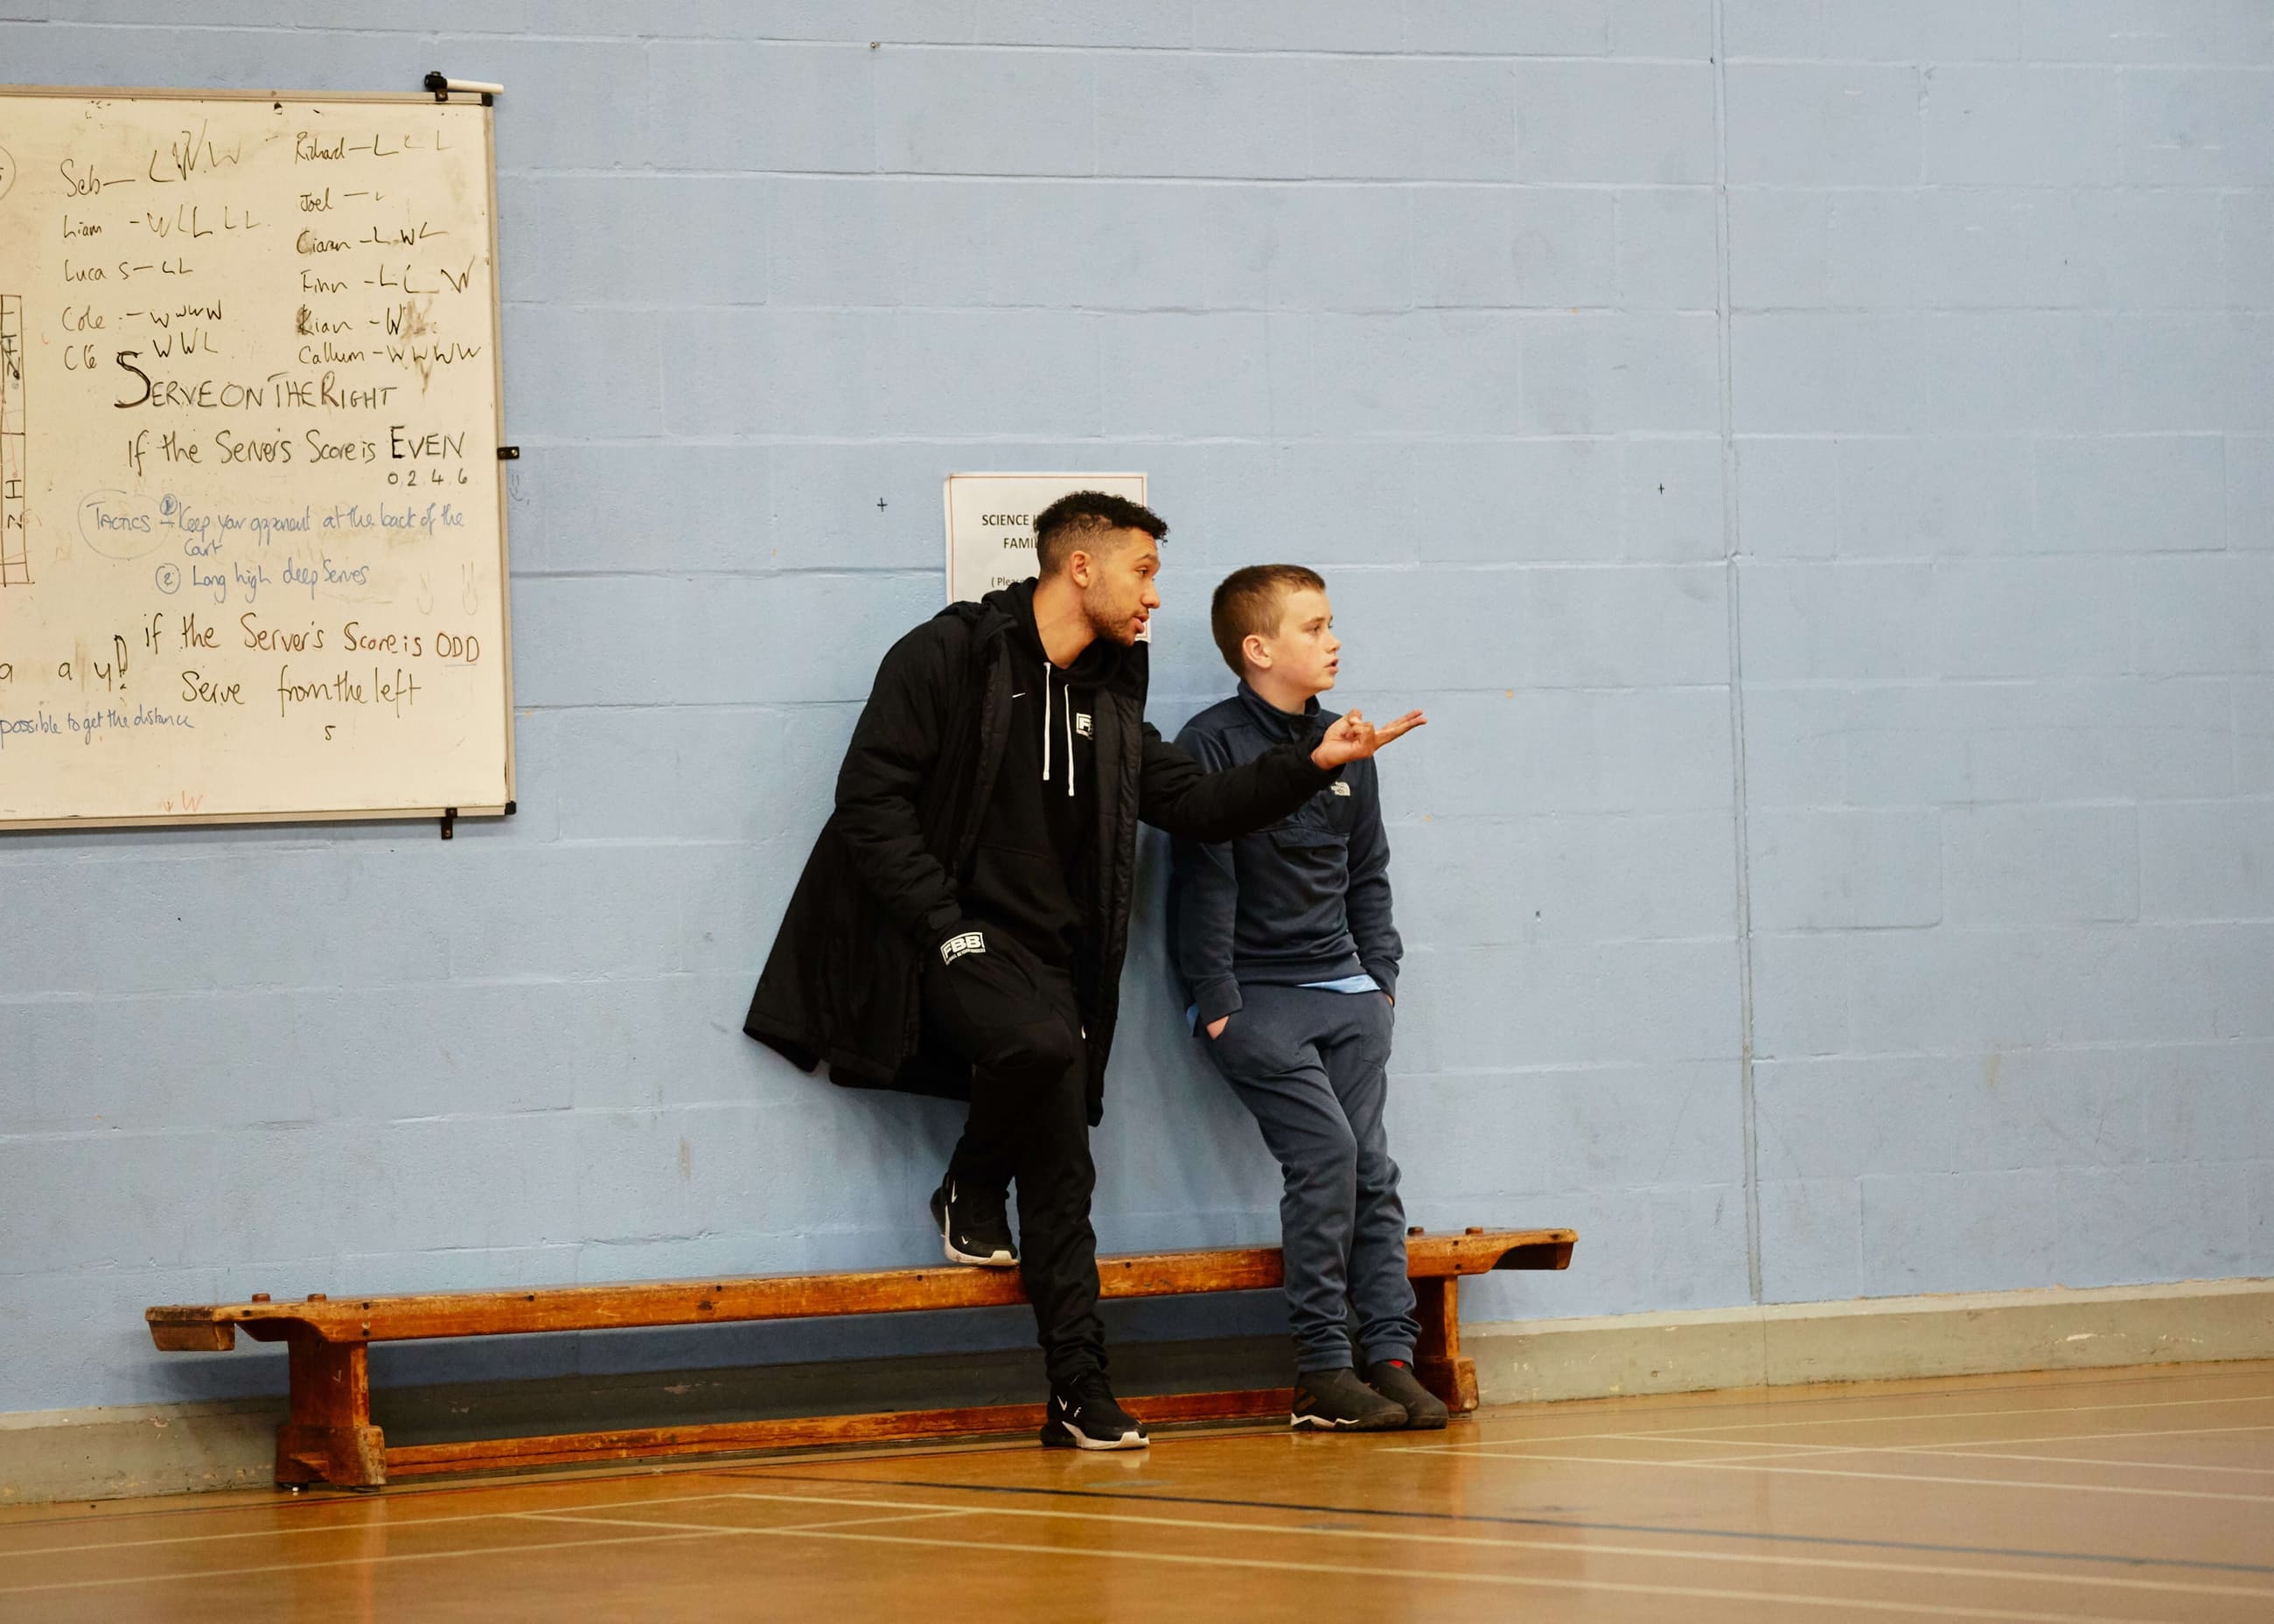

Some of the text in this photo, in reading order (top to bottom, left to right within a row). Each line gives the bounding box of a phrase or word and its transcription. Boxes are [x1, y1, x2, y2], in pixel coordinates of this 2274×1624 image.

[300, 187, 333, 212] Joel
[64, 259, 108, 282] Luca
[268, 372, 317, 408] THE
[321, 370, 399, 409] RIGHT
[157, 430, 203, 463] the
[305, 429, 358, 464] Score
[362, 441, 376, 464] is
[390, 425, 465, 460] EVEN
[380, 502, 417, 529] back
[420, 502, 437, 535] of
[440, 503, 466, 528] the
[982, 514, 1029, 526] SCIENCE
[1003, 537, 1038, 549] FAMIL
[234, 561, 272, 603] high
[283, 556, 318, 600] deep
[181, 612, 221, 649] the
[344, 621, 398, 653] Score
[403, 636, 422, 657] is
[436, 631, 480, 663] ODD
[181, 665, 422, 719] Serve from the left
[0, 707, 63, 749] possible
[66, 713, 80, 732] to
[82, 711, 104, 745] get
[107, 708, 131, 728] the
[943, 935, 981, 959] FBB
